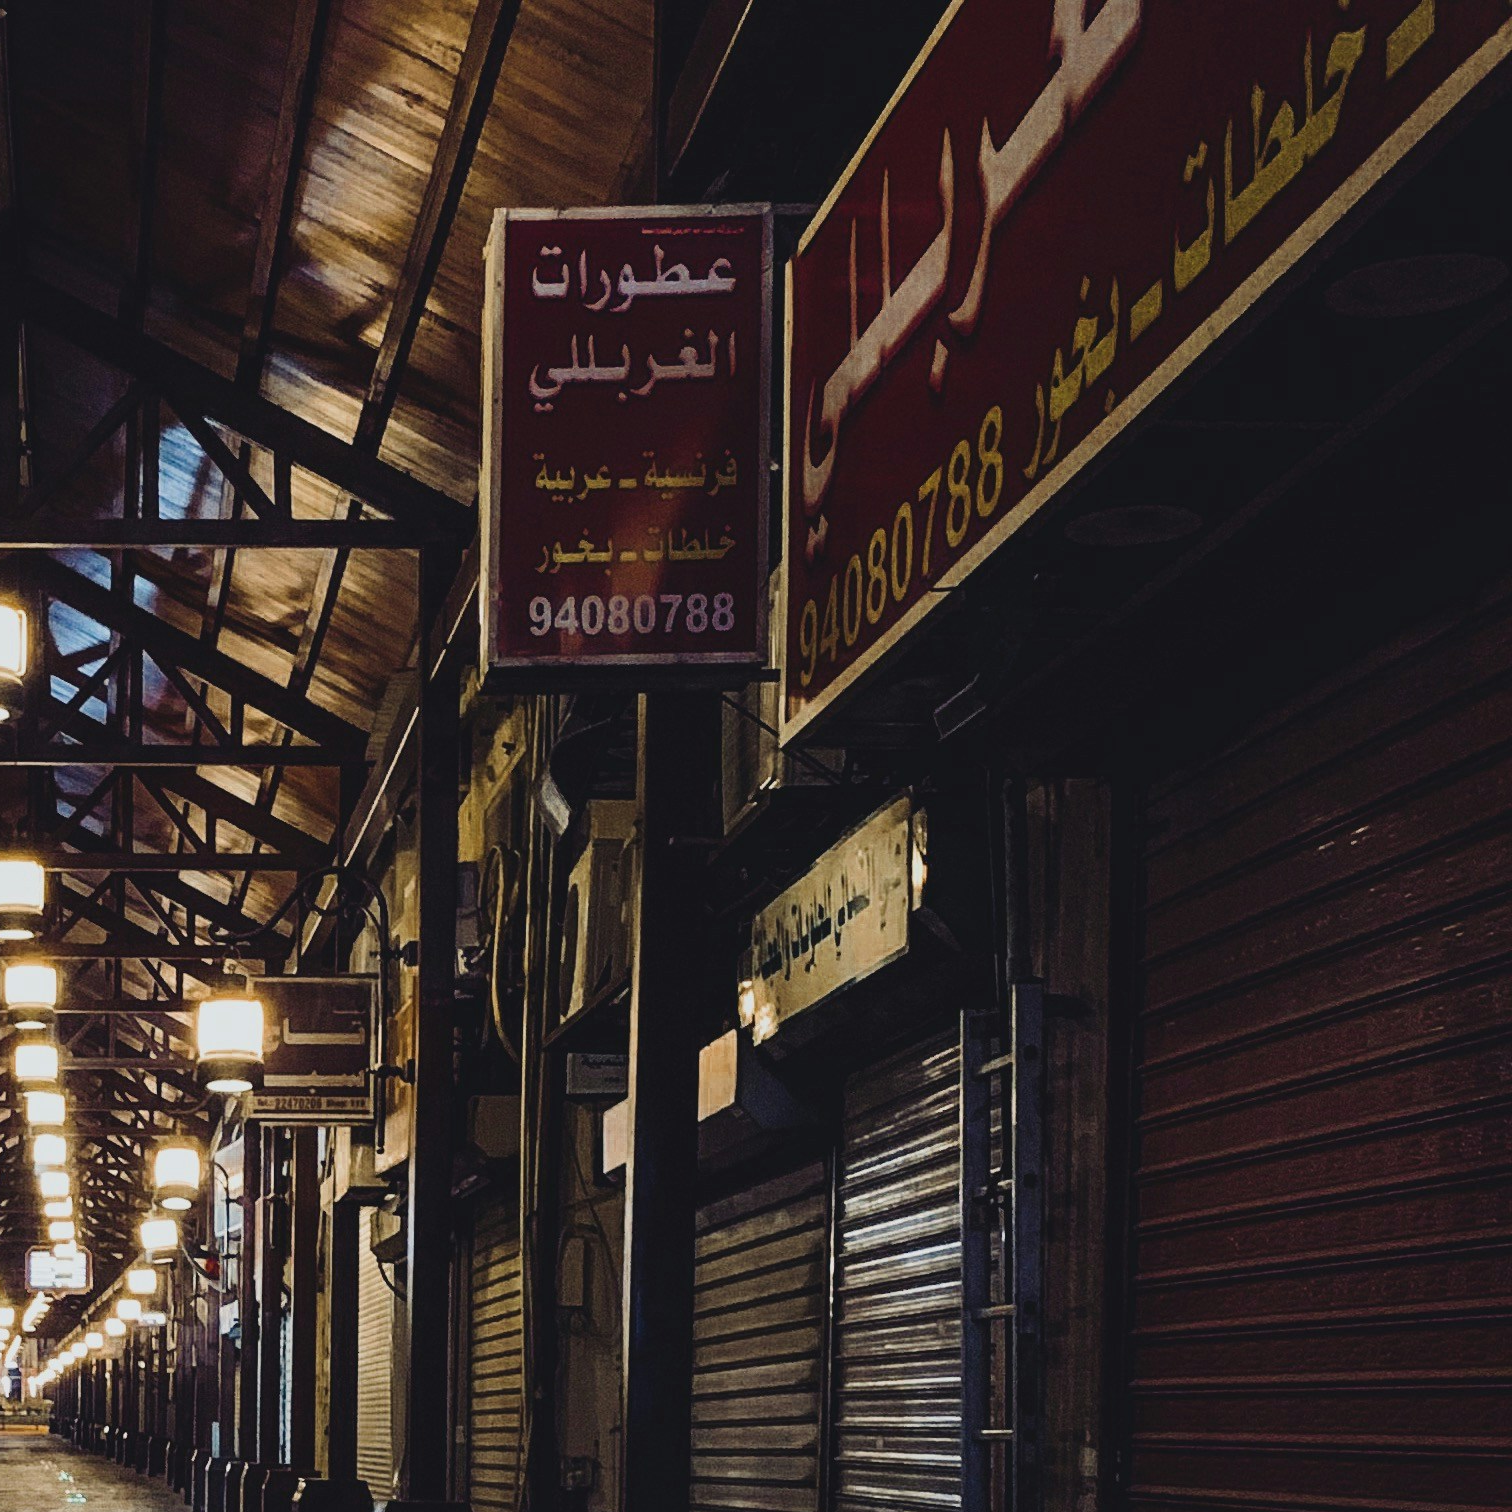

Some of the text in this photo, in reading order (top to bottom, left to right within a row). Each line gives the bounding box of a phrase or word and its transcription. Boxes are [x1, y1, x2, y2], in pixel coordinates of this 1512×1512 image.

[532, 243, 737, 312] عطورات
[528, 327, 737, 413] الغربللي
[1023, 273, 1121, 479] بخور
[533, 452, 612, 504] عربية
[644, 449, 738, 499] فرنسية
[534, 528, 613, 575] بخور
[643, 523, 737, 563] خلطات
[799, 404, 1004, 687] 94080788
[529, 592, 736, 637] 94080788
